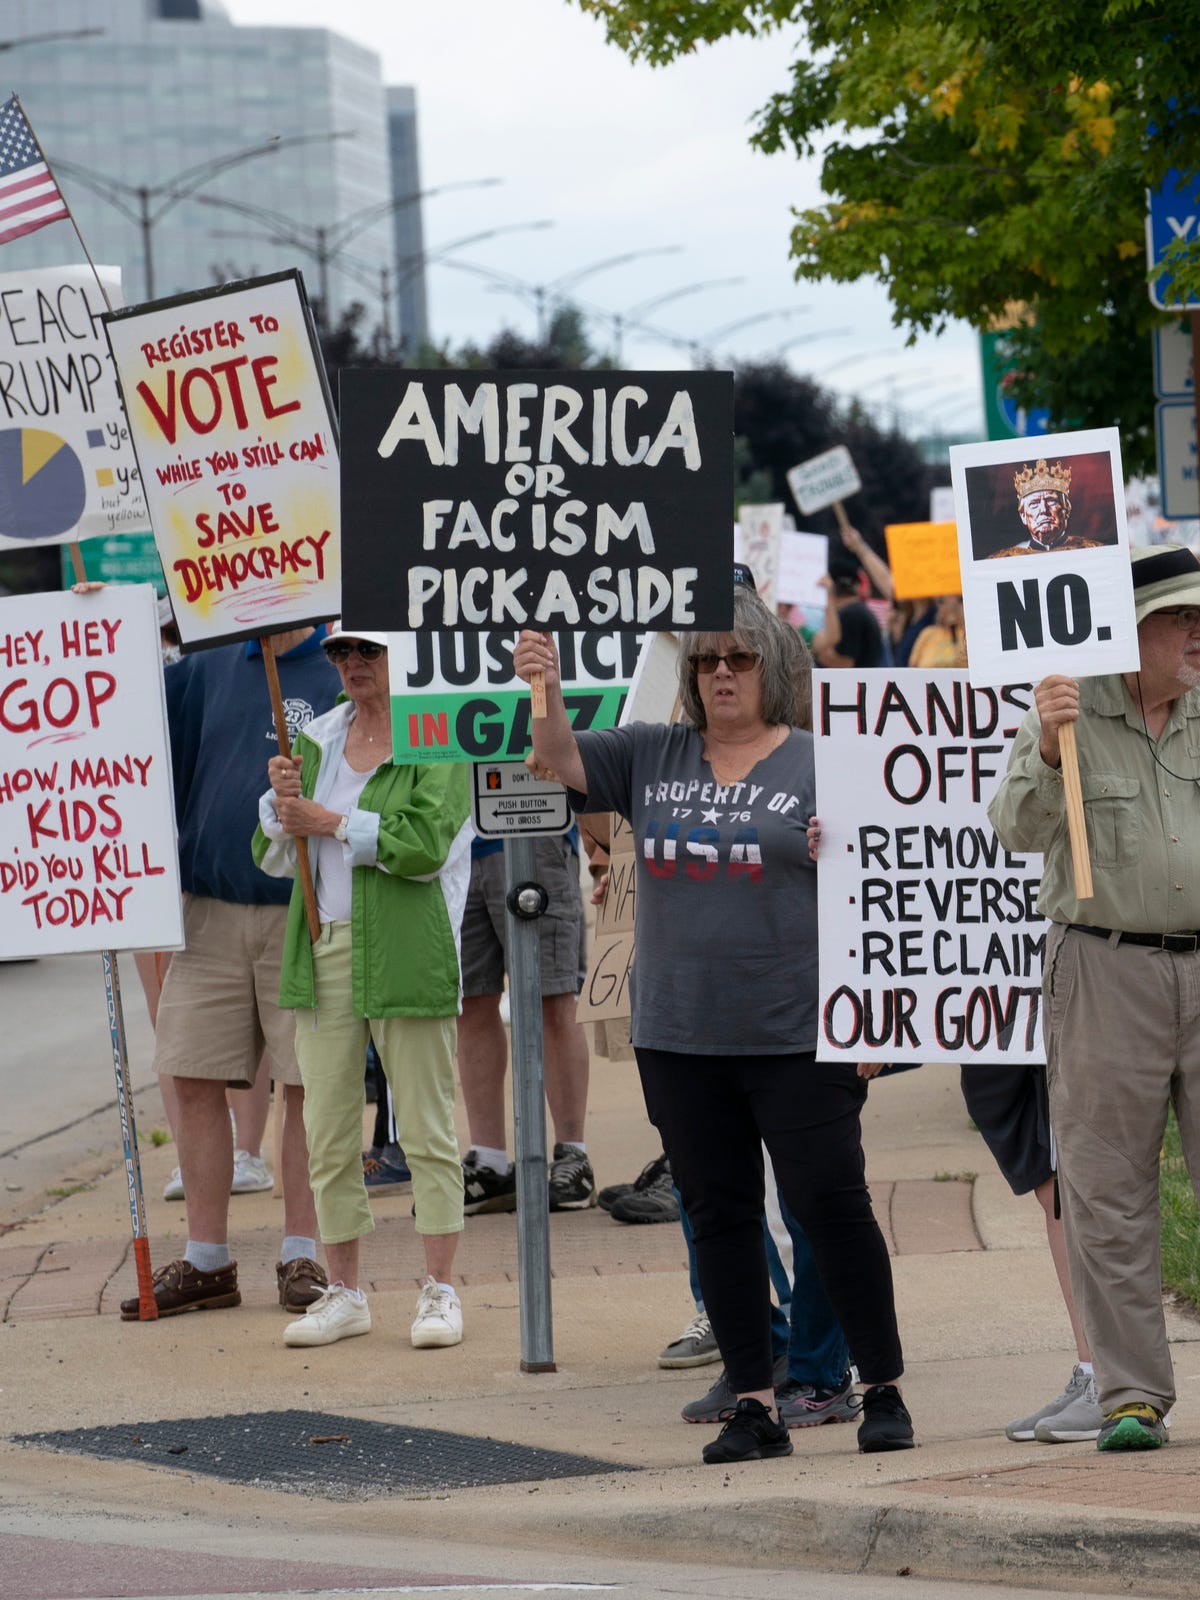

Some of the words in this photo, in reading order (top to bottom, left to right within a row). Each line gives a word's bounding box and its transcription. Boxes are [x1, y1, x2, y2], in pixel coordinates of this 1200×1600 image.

[0, 284, 101, 346] EACH
[249, 314, 279, 334] TO
[0, 353, 124, 418] RUMP
[136, 355, 301, 445] VOTE
[106, 422, 128, 450] ye
[377, 381, 702, 471] AMERICA
[117, 467, 139, 496] ye
[205, 451, 239, 475] YOU
[504, 462, 571, 497] OR
[216, 483, 247, 506] TO
[195, 502, 279, 548] SAVE
[422, 498, 655, 555] FACISM
[173, 530, 331, 603] DEMOCRACY
[408, 566, 529, 628] PICK
[534, 569, 580, 624] A
[587, 566, 698, 624] SIDE
[997, 573, 1112, 651] NO.
[61, 619, 122, 658] HEY
[407, 631, 641, 687] JUSICE
[0, 671, 117, 733] GOP
[285, 710, 300, 723] 23
[408, 712, 449, 747] IN
[455, 694, 628, 757] GAZ
[820, 680, 1034, 738] HANDS
[0, 761, 58, 803] HOW
[70, 754, 153, 791] MANY
[512, 772, 530, 783] DON'T
[644, 778, 764, 806] PROPERTY
[767, 791, 800, 815] OF
[883, 744, 1004, 805] OFF
[498, 800, 517, 809] PUSH
[520, 799, 548, 808] BUTTON
[506, 817, 514, 826] TO
[672, 807, 692, 818] 17
[729, 811, 751, 823] 76
[41, 853, 83, 882] YOU
[644, 819, 764, 883] USA
[22, 886, 133, 928] TODAY
[861, 877, 1046, 924] REVERSE
[861, 930, 1047, 977] RECLAIM
[823, 985, 922, 1050] OUR
